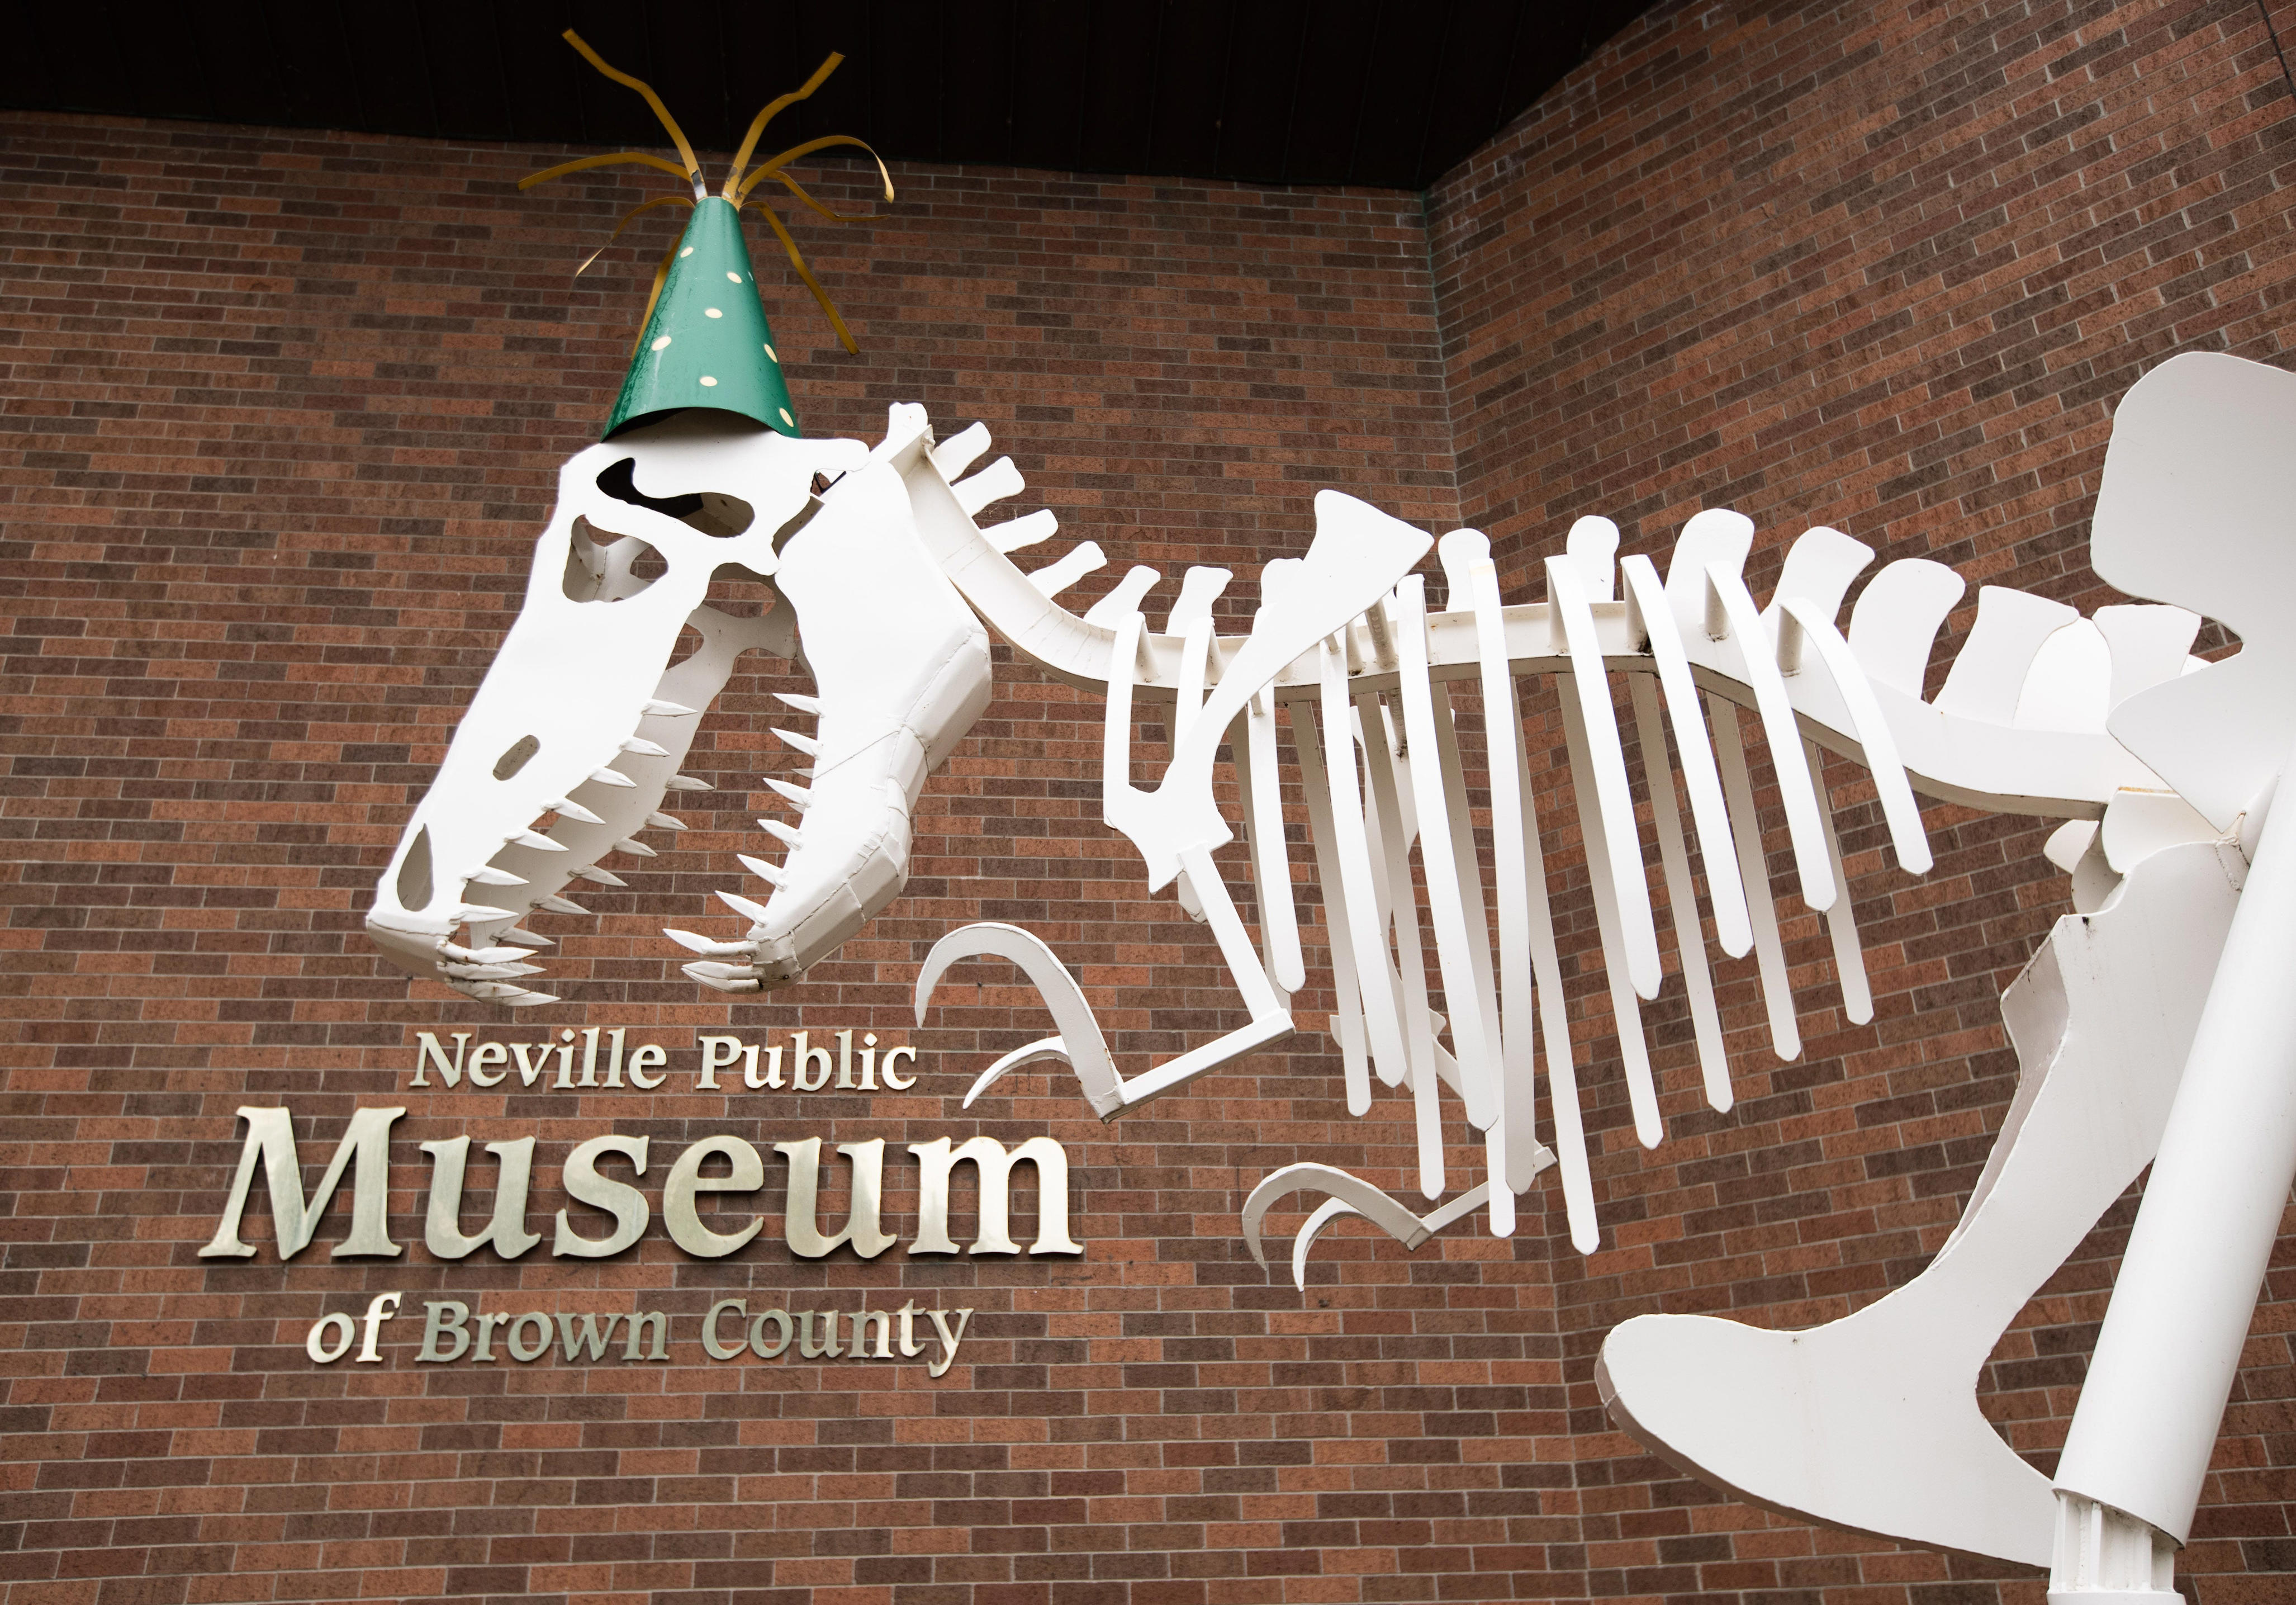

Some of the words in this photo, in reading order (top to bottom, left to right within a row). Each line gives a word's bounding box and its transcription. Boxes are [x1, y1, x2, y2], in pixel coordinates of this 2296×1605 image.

[410, 1027, 667, 1089] Neville
[696, 1030, 917, 1091] Public
[198, 1106, 1084, 1260] Museum
[306, 1292, 401, 1363] of
[416, 1300, 670, 1362] Brown
[703, 1298, 974, 1377] County
